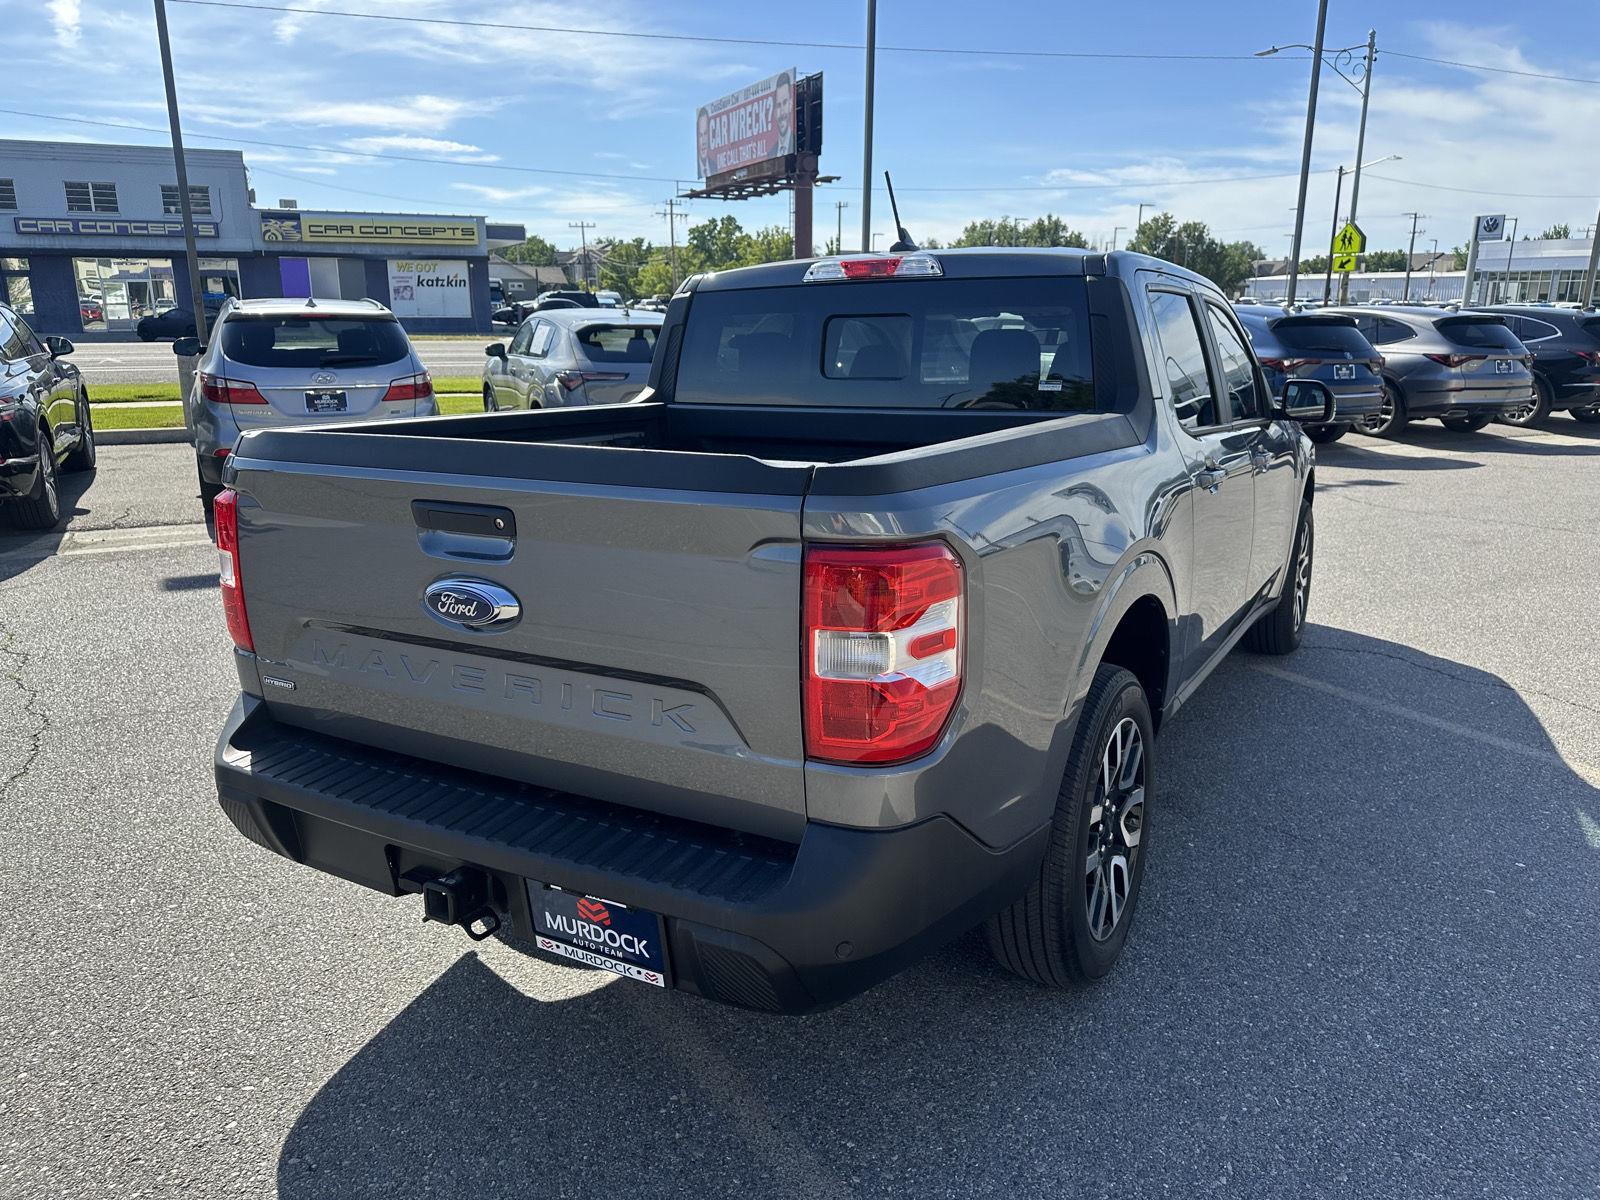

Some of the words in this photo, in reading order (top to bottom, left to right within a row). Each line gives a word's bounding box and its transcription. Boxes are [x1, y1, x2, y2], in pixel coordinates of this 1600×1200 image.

[709, 114, 727, 150] CAR
[730, 97, 773, 142] WRECK?
[728, 149, 739, 166] CALL
[757, 140, 768, 159] ALL
[18, 220, 73, 233] CAR
[308, 224, 354, 235] CAR
[359, 225, 475, 236] CONCEPTS
[396, 262, 413, 273] WE
[416, 263, 438, 273] GOT
[416, 273, 467, 288] katzkin
[437, 591, 478, 617] Ford
[265, 677, 292, 689] HYBRID
[312, 639, 697, 734] MAVERICK
[544, 911, 650, 958] MURDOCK
[572, 937, 596, 950] AUTO
[600, 946, 624, 959] TEAM
[564, 946, 634, 976] MURDOCK
